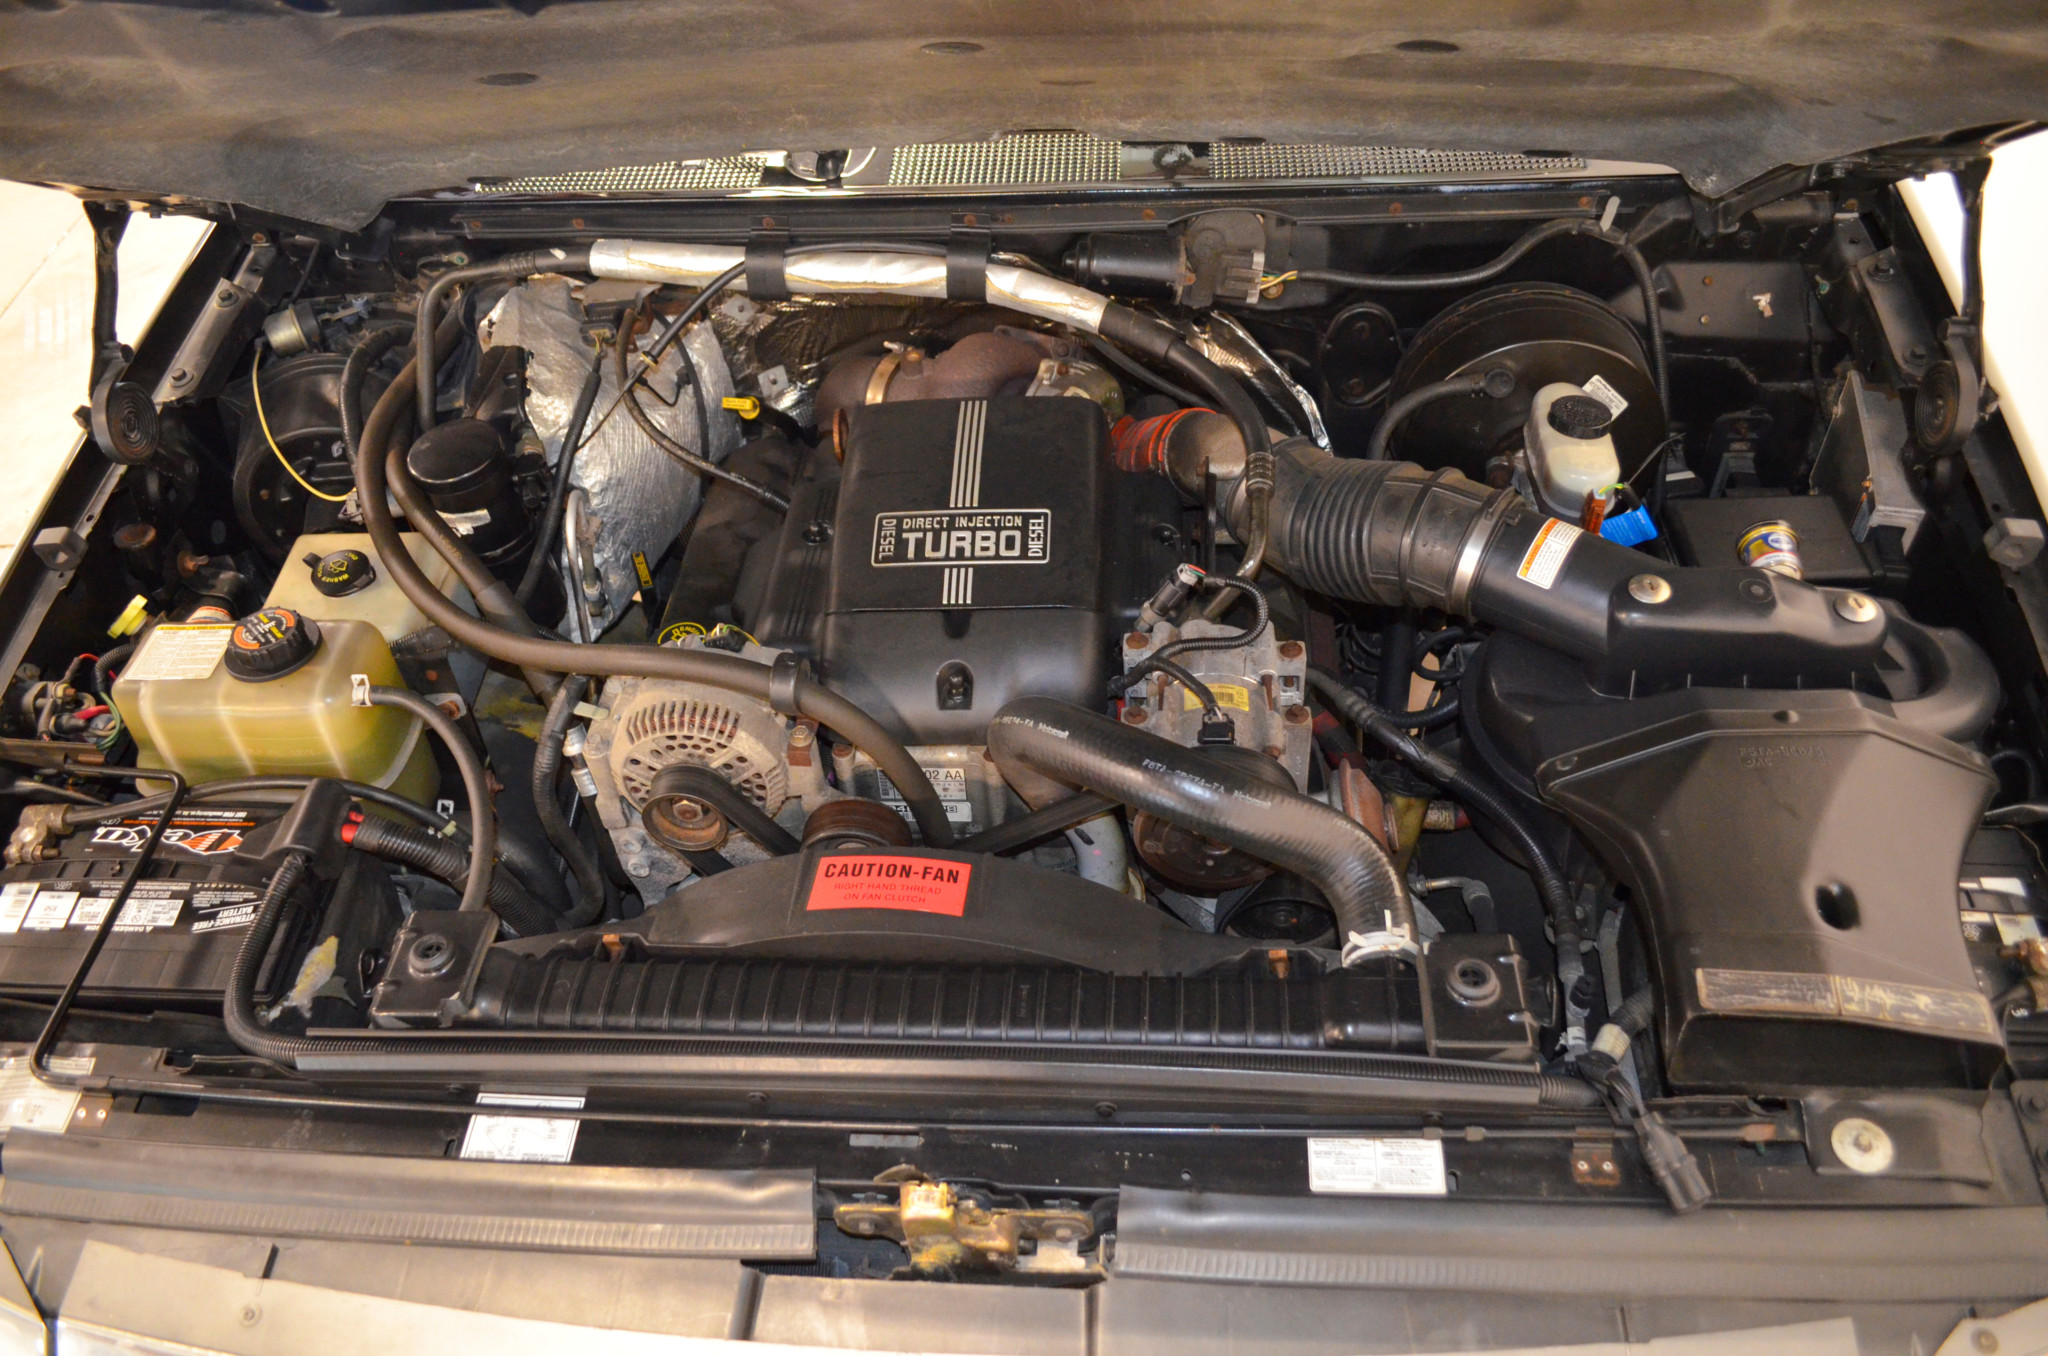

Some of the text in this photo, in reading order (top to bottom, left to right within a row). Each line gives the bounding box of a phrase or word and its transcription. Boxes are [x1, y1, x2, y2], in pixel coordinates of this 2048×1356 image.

[902, 515, 1023, 529] DIRECT INJECTION
[879, 518, 897, 561] DIESEL
[1028, 515, 1045, 557] DIESEL
[902, 529, 1022, 560] TURBO
[944, 770, 963, 780] AA
[824, 863, 960, 884] CAUTION-FAN
[833, 882, 942, 895] RIGHT HAND THREAD
[843, 893, 926, 904] ON FAN CLUTCH
[217, 905, 255, 918] BATTERY
